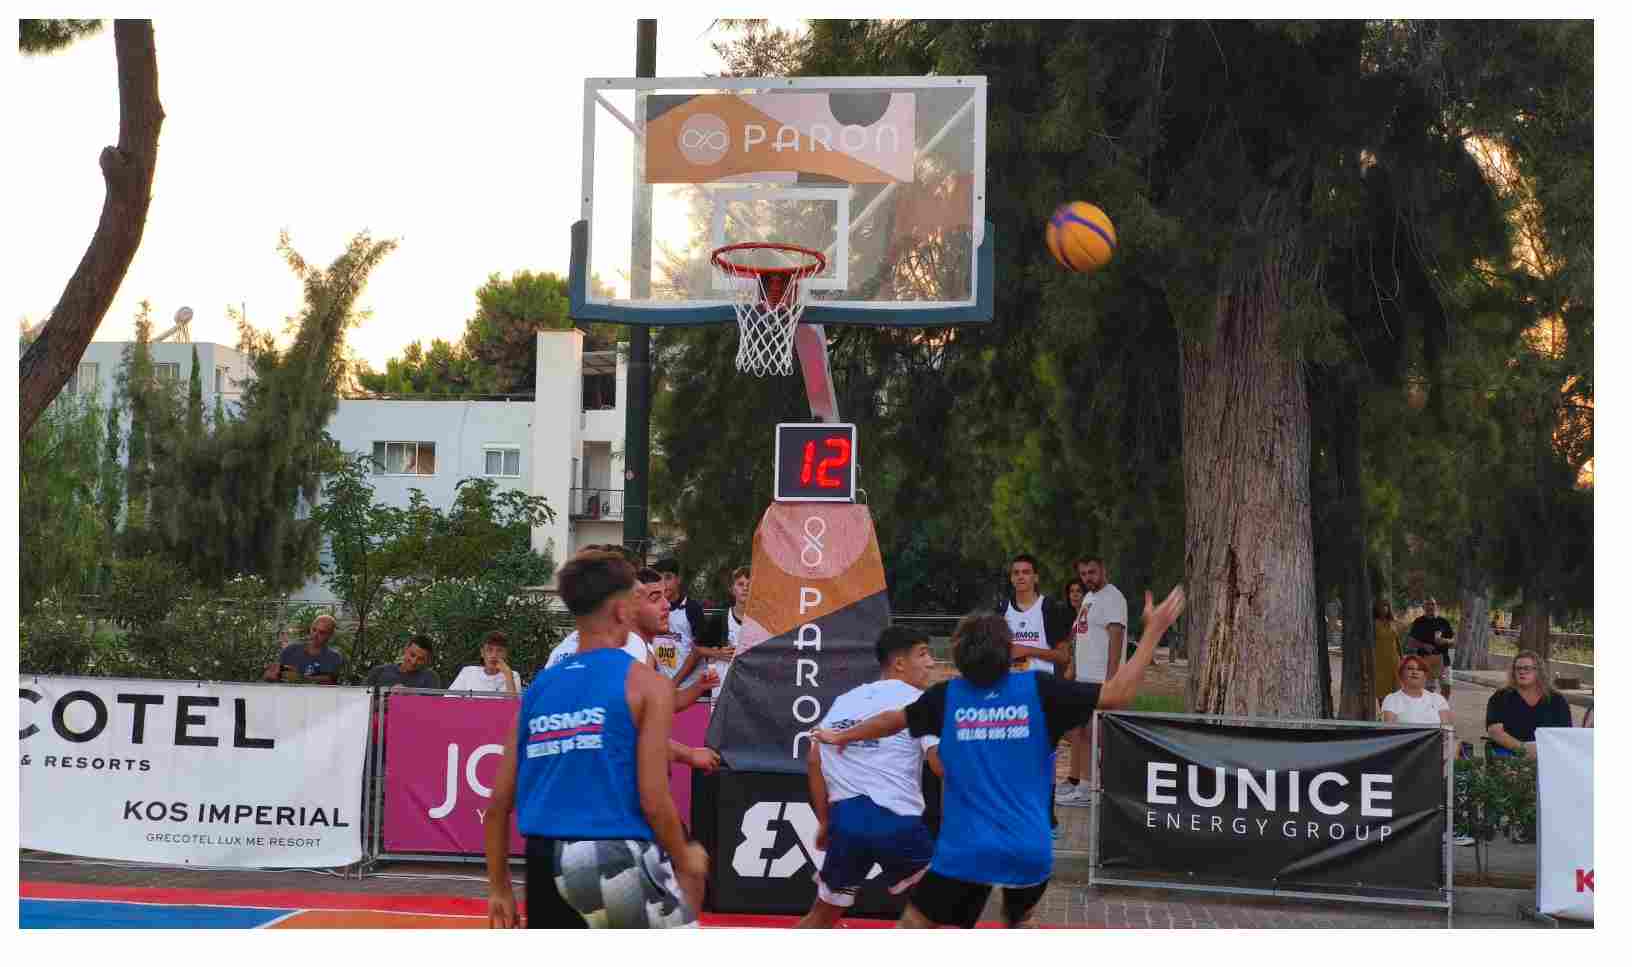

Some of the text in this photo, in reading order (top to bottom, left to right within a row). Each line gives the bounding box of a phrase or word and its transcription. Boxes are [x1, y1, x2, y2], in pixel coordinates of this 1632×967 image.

[798, 435, 851, 489] 12
[955, 704, 1029, 723] COSMOS
[20, 754, 152, 772] & RESORTS
[1147, 761, 1393, 818] EUNICE
[123, 800, 350, 828] KOS IMPERIAL
[1146, 810, 1393, 843] ENERGY GROUP
[146, 832, 322, 849] GRECOTEL LUX ME RESORT
